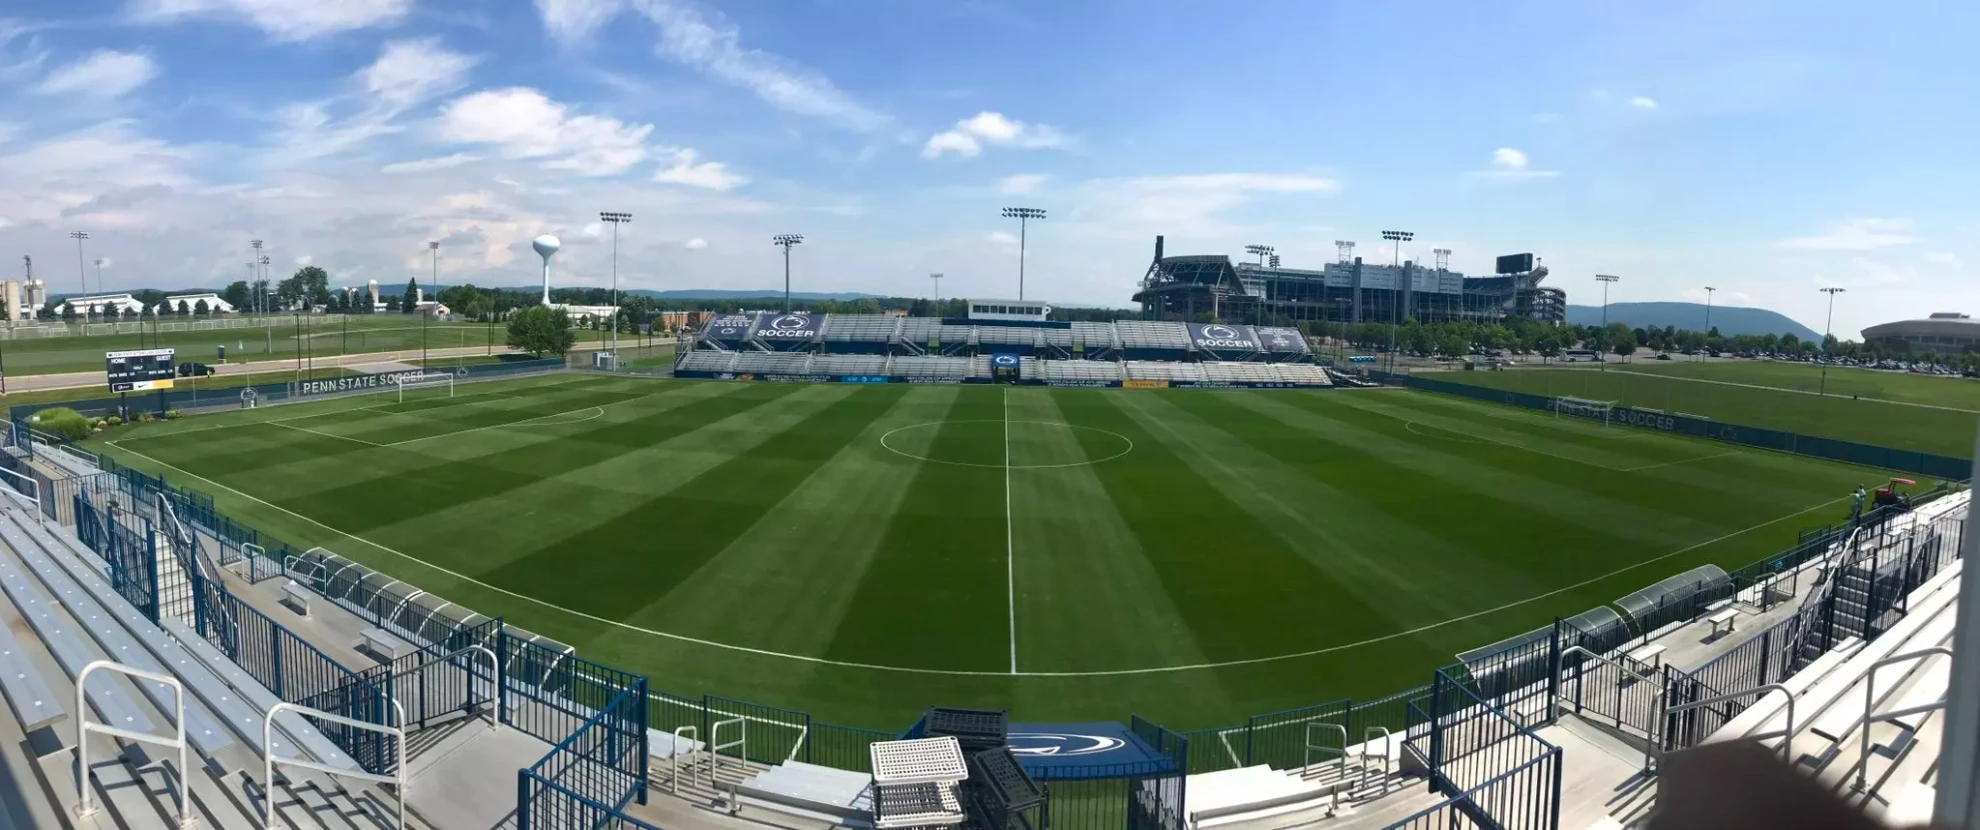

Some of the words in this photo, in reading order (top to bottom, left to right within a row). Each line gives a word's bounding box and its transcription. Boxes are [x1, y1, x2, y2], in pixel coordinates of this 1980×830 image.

[757, 329, 814, 337] SOCCER
[1196, 338, 1253, 347] SOCCER
[303, 380, 337, 394] PENN
[339, 376, 376, 390] STATE
[379, 370, 424, 385] SOCCER
[1619, 410, 1674, 430] SOCCER
